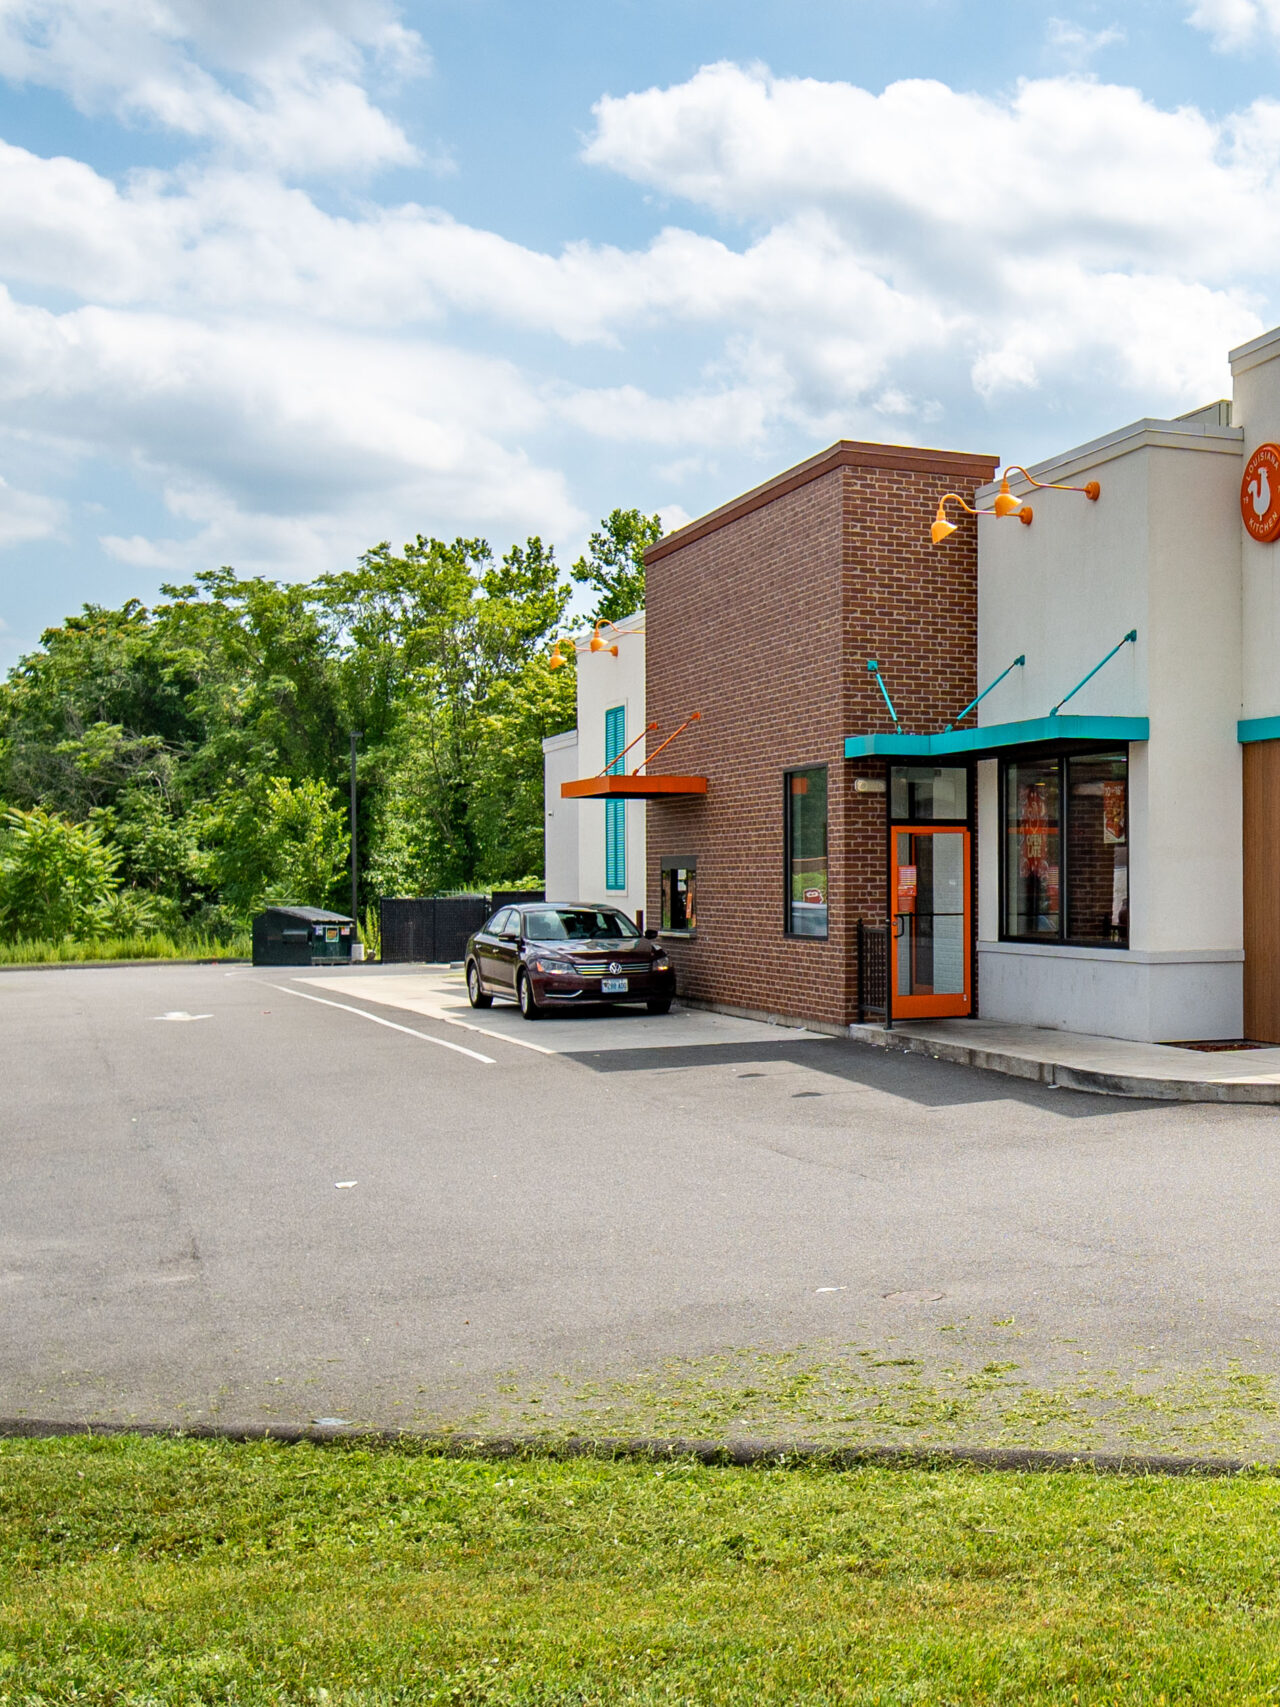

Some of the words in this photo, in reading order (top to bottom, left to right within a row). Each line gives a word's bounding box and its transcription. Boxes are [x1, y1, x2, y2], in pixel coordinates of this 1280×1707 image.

[1246, 451, 1279, 481] LOUISIANA
[1249, 511, 1278, 534] KITCHEN
[1026, 834, 1042, 846] OPEN
[1027, 846, 1042, 858] LATE
